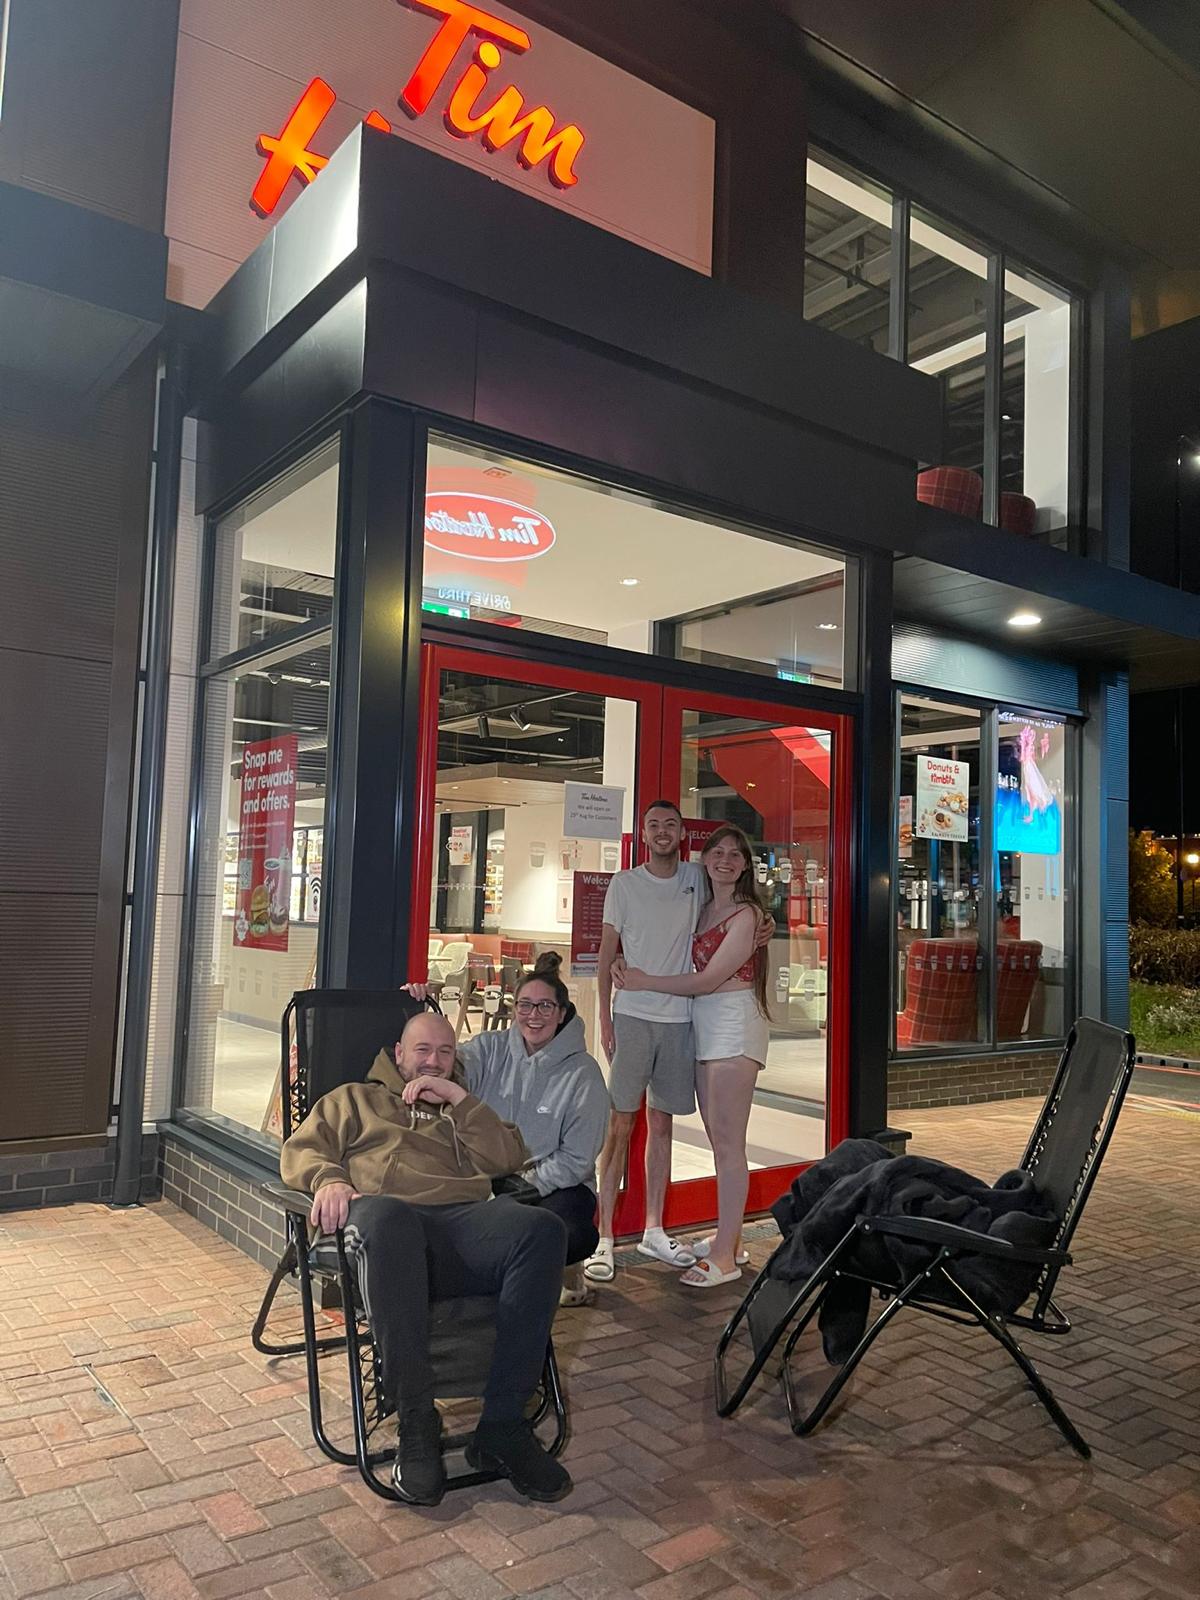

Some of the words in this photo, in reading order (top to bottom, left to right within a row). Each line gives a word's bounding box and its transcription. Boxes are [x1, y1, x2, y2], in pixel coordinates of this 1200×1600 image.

[399, 0, 586, 189] Tim
[245, 750, 267, 773] Snap
[268, 748, 283, 764] me
[927, 760, 953, 773] Donuts
[954, 765, 960, 775] &
[244, 772, 257, 792] for
[257, 763, 294, 790] rewards
[243, 792, 260, 814] and
[261, 790, 290, 811] offers.
[582, 874, 610, 886] Welco
